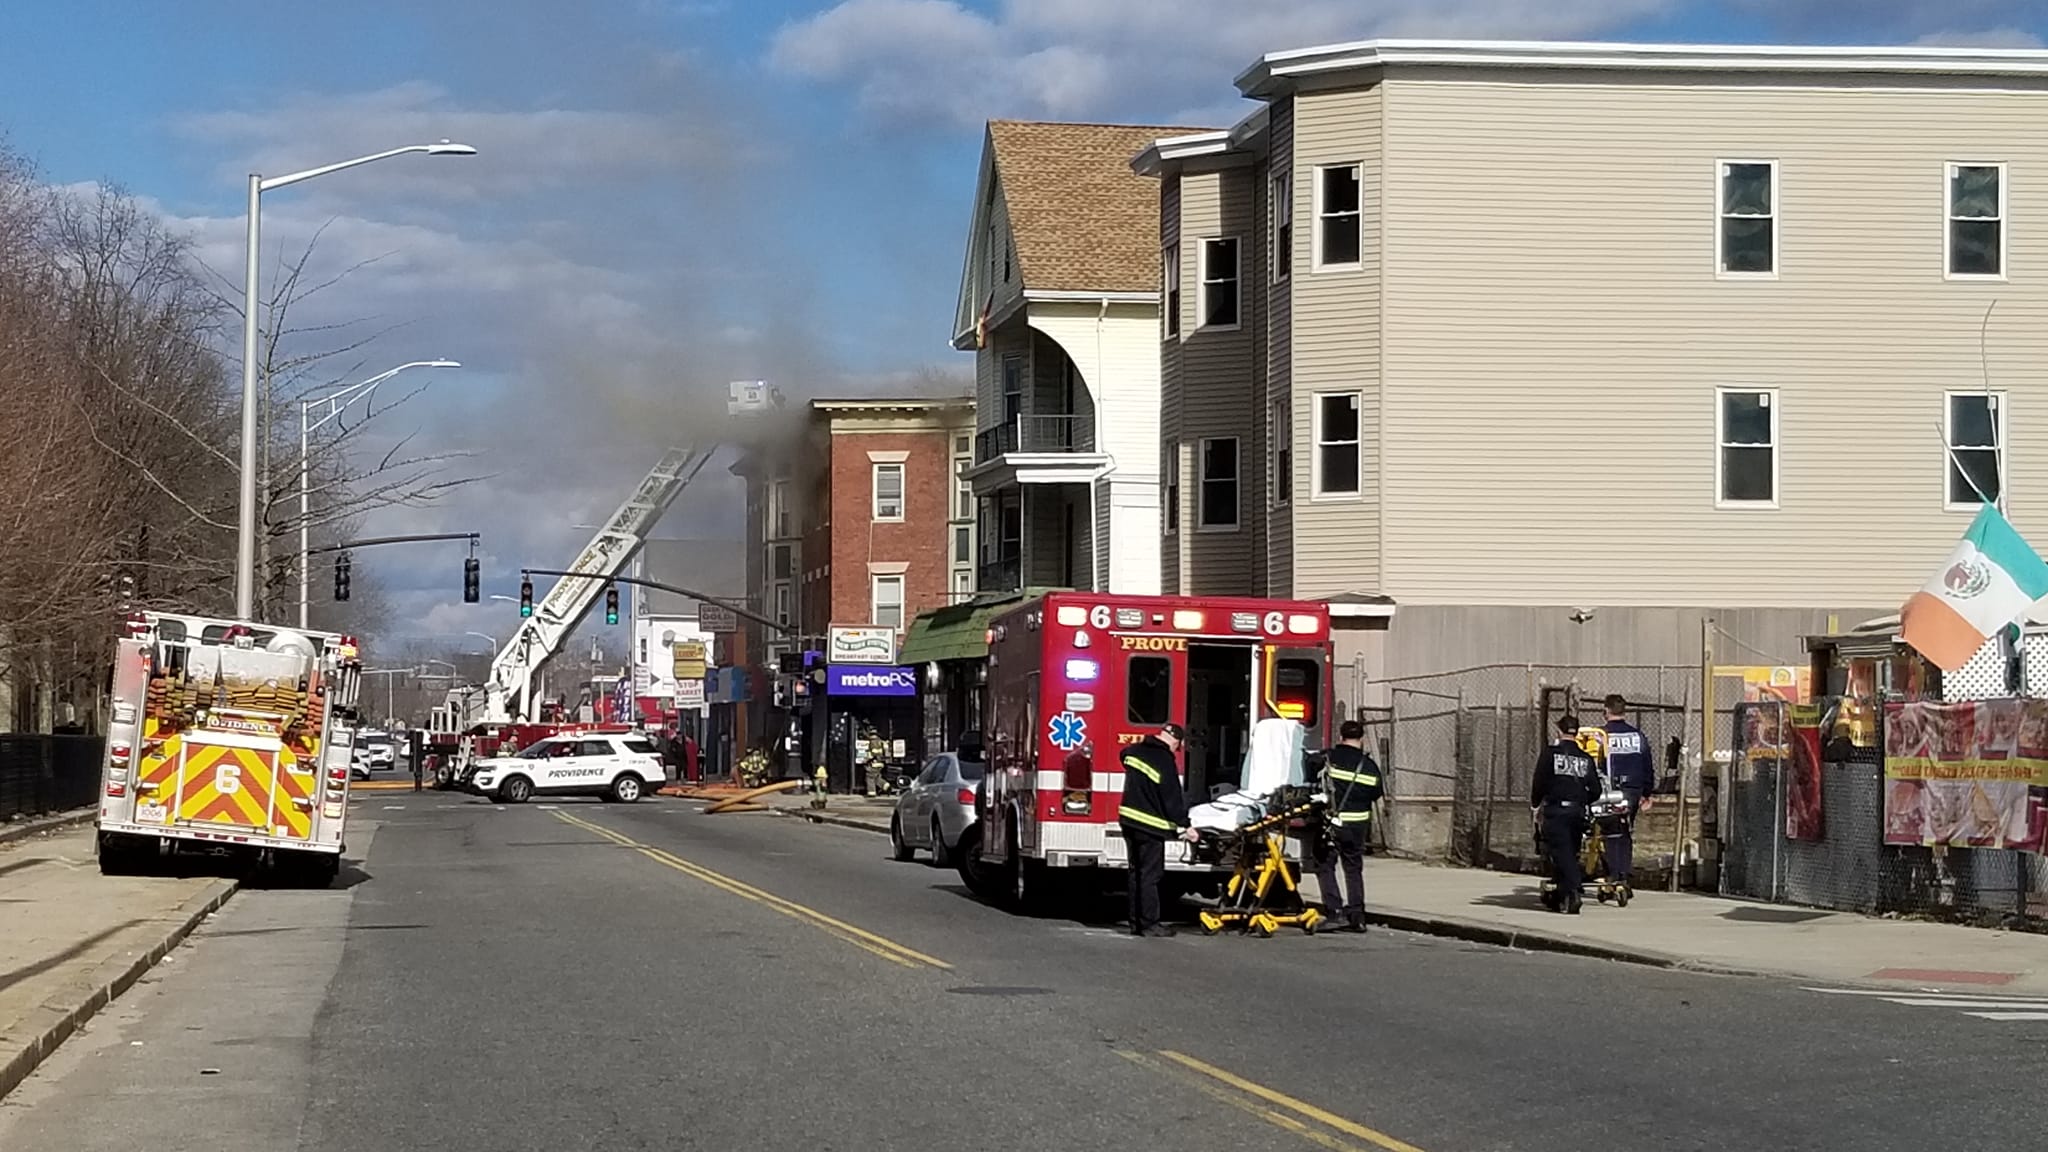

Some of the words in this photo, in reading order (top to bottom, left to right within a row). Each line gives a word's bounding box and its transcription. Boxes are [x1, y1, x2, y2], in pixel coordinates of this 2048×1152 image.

[550, 550, 597, 608] PROVINCE
[1090, 605, 1112, 629] 6
[1263, 611, 1285, 635] 6
[1120, 636, 1188, 651] PROVI
[210, 719, 276, 732] OVIDENCE
[1117, 733, 1145, 744] FI
[1608, 736, 1640, 748] FIRE
[548, 768, 605, 778] PROVIDENCE
[1554, 756, 1588, 775] FIRE
[215, 764, 241, 794] 6
